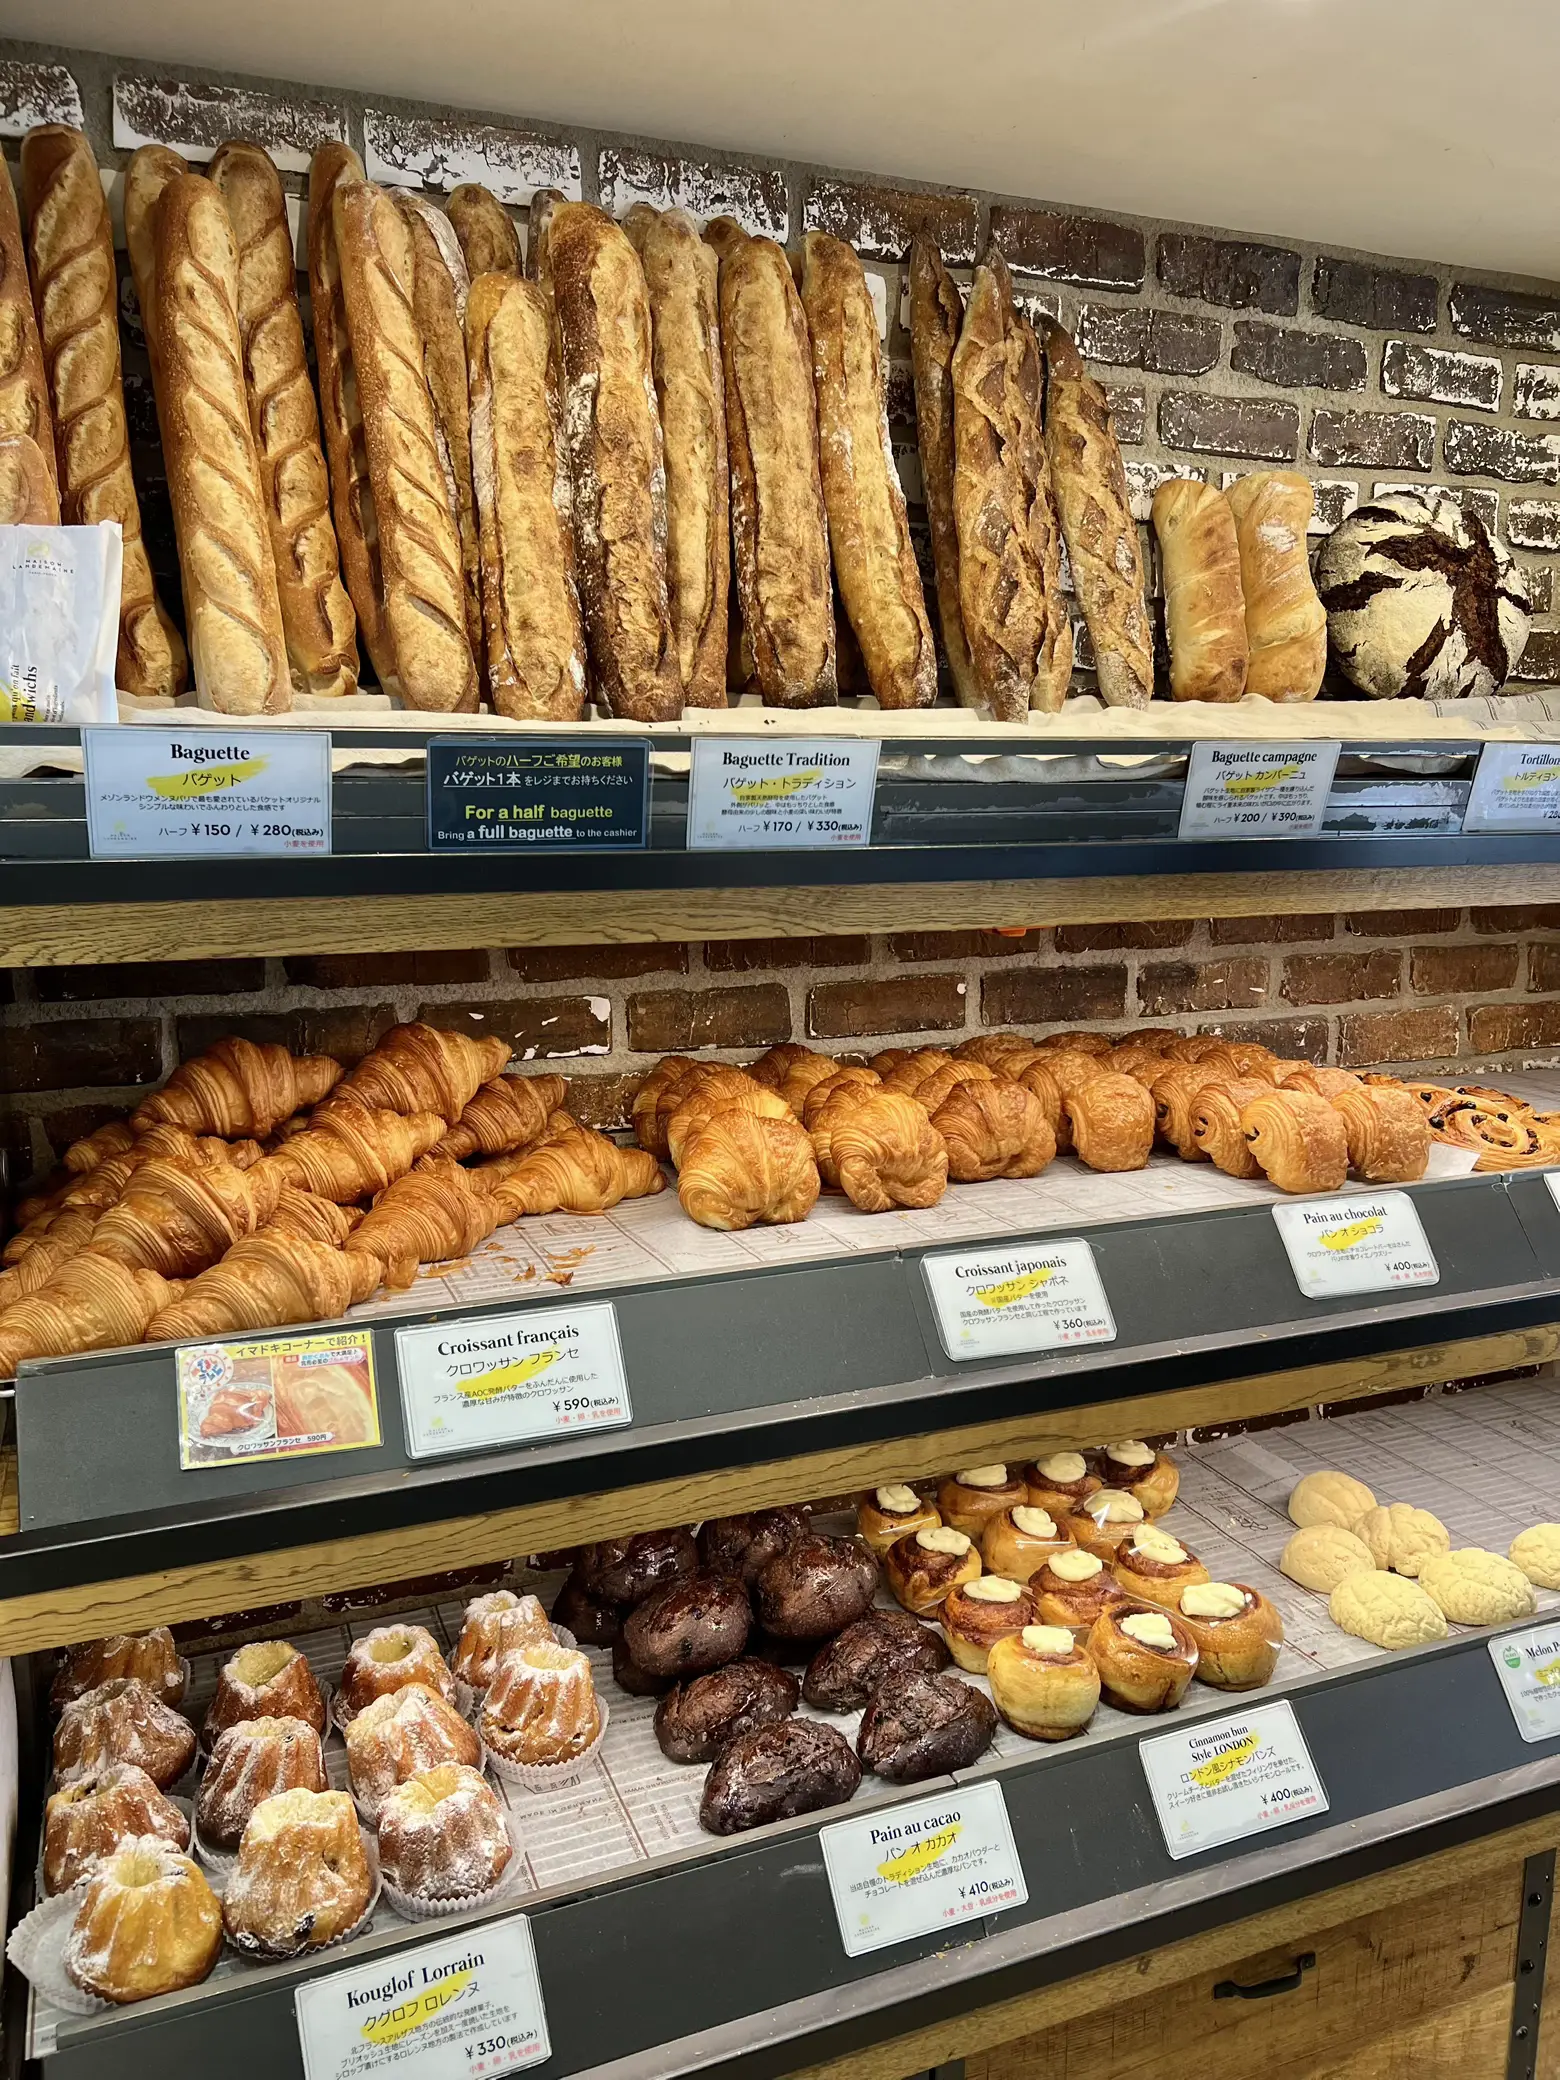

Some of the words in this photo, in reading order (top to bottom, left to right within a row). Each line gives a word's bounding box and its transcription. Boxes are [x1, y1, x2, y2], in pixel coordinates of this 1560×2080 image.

[13, 564, 74, 574] LANDEMAINE
[26, 559, 61, 567] MAISON
[170, 744, 249, 763] Baguette
[456, 754, 623, 768] バゲットのハーフご希望のお客様
[723, 752, 783, 769] Baguette
[787, 752, 850, 766] Tradition
[1212, 751, 1260, 765] Baguette
[1262, 752, 1317, 764] campagne
[182, 773, 242, 787] バゲット
[524, 775, 633, 786] をレジまでお持ちください
[723, 777, 857, 789] バゲット・トラディション
[1216, 771, 1252, 781] バゲット
[1255, 770, 1306, 780] カンパーニュ
[1514, 772, 1559, 781] トルティヨン
[465, 805, 493, 819] For
[498, 808, 508, 819] a
[513, 805, 545, 819] half
[550, 807, 613, 820] baguette
[1261, 813, 1267, 823] /
[159, 827, 188, 837] ハーフ
[235, 824, 242, 837] /
[438, 831, 465, 841] Bring
[467, 830, 475, 839] a
[478, 825, 504, 839] full
[509, 826, 573, 840] baguette
[587, 829, 602, 837] the
[603, 829, 637, 837] cashier
[796, 821, 801, 832] /
[1303, 1213, 1328, 1224] Pain
[1330, 1212, 1343, 1221] au
[1345, 1206, 1388, 1219] chocolat
[1321, 1230, 1337, 1239] パン
[1340, 1227, 1349, 1236] オ
[1351, 1224, 1384, 1235] ショコラ
[955, 1262, 1015, 1278] Croissant
[1016, 1256, 1067, 1275] japonais
[966, 1280, 1026, 1297] クロワッサン
[1030, 1275, 1069, 1288] ジャポネ
[236, 1334, 366, 1356] イマドキコーナーで紹介！
[437, 1334, 514, 1356] Croissant
[517, 1325, 579, 1345] français
[446, 1357, 524, 1377] クロワッサン
[529, 1348, 580, 1365] フランセ
[434, 1372, 598, 1404] フランス産AOC発酵バターをふんだんに使用した
[462, 1386, 574, 1409] 濃厚な甘みが特徴のクロワッサン
[237, 1437, 301, 1451] クロワッサンフランセ
[307, 1434, 327, 1442] 590円
[1525, 1645, 1553, 1658] Melon
[1188, 1731, 1231, 1749] Cinnamon
[1231, 1726, 1248, 1737] bun
[1192, 1751, 1212, 1763] Style
[1214, 1736, 1254, 1756] LONDON
[869, 1827, 902, 1844] Pain
[904, 1824, 921, 1835] au
[924, 1811, 961, 1830] cacao
[885, 1847, 906, 1862] パン
[911, 1841, 921, 1855] オ
[926, 1831, 957, 1851] カカオ
[864, 1860, 988, 1898] チョコレートを混ぜ込んだ濃厚なパンです。
[347, 1969, 415, 2009] Kouglof
[421, 1953, 485, 1985] Lorrain
[363, 2003, 419, 2032] クグロフ
[425, 1981, 481, 2011] ロレンヌ
